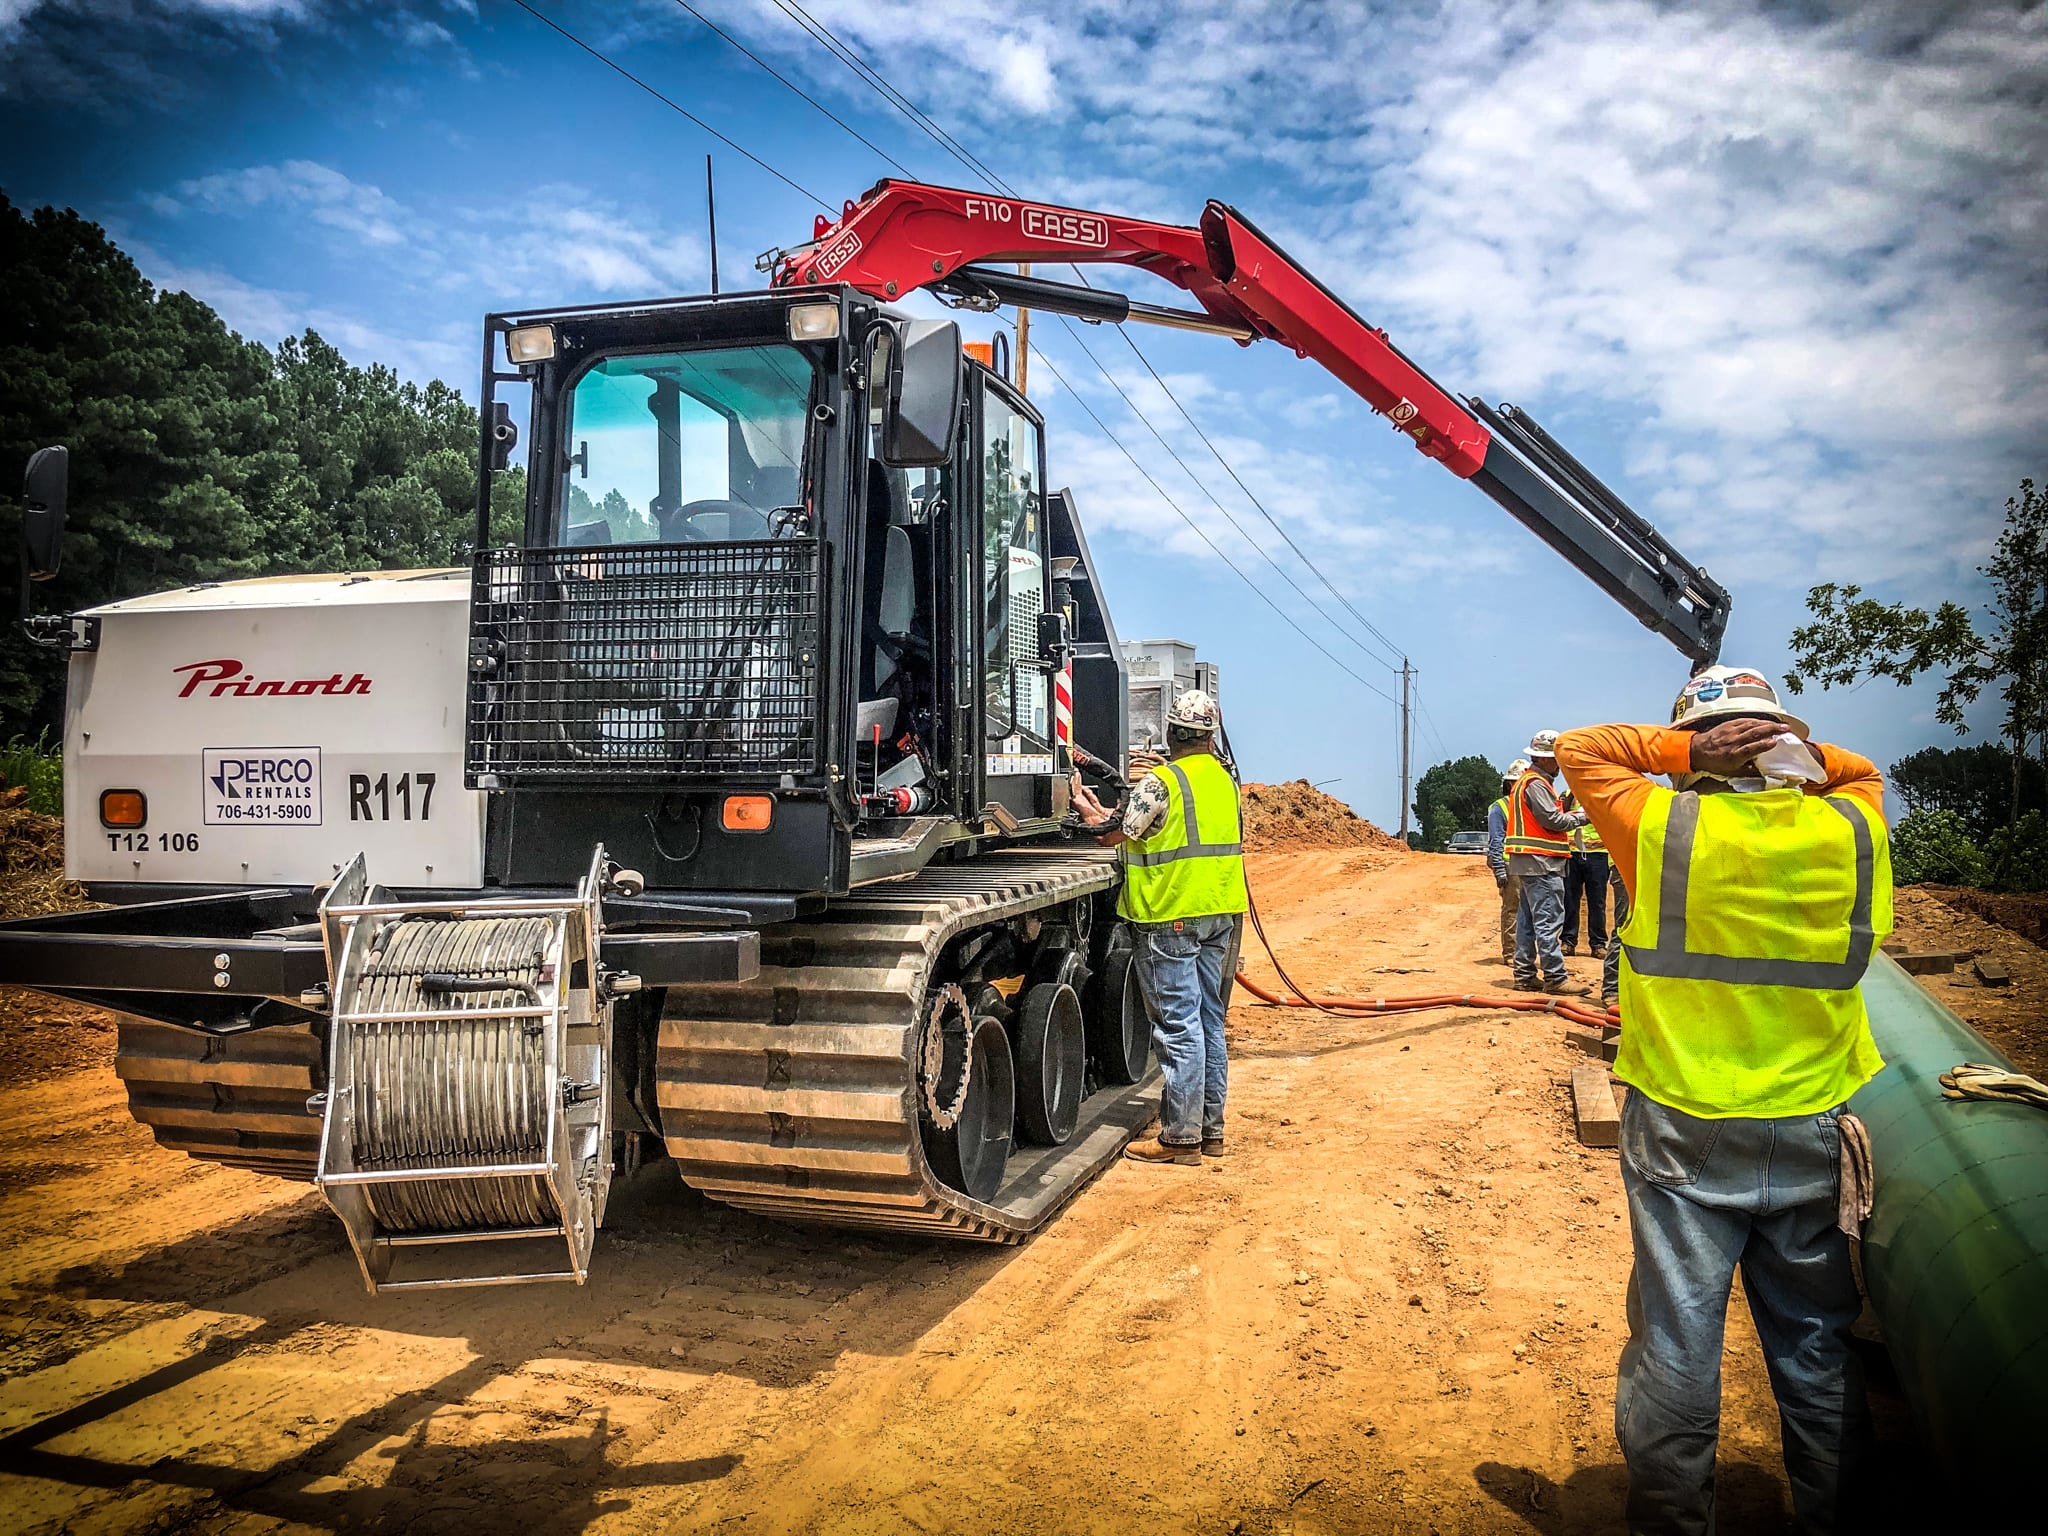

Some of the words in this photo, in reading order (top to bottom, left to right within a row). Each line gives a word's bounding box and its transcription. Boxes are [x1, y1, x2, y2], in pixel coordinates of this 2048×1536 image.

[964, 199, 1012, 223] F110
[1027, 211, 1103, 244] FASSI
[820, 235, 860, 275] FASSI
[173, 659, 373, 698] Prinoth
[211, 758, 313, 790] PERCO
[245, 786, 312, 799] RENTALS
[349, 772, 437, 821] R117
[216, 804, 312, 820] 706-431-5900
[107, 833, 149, 852] T12
[158, 832, 200, 853] 106
